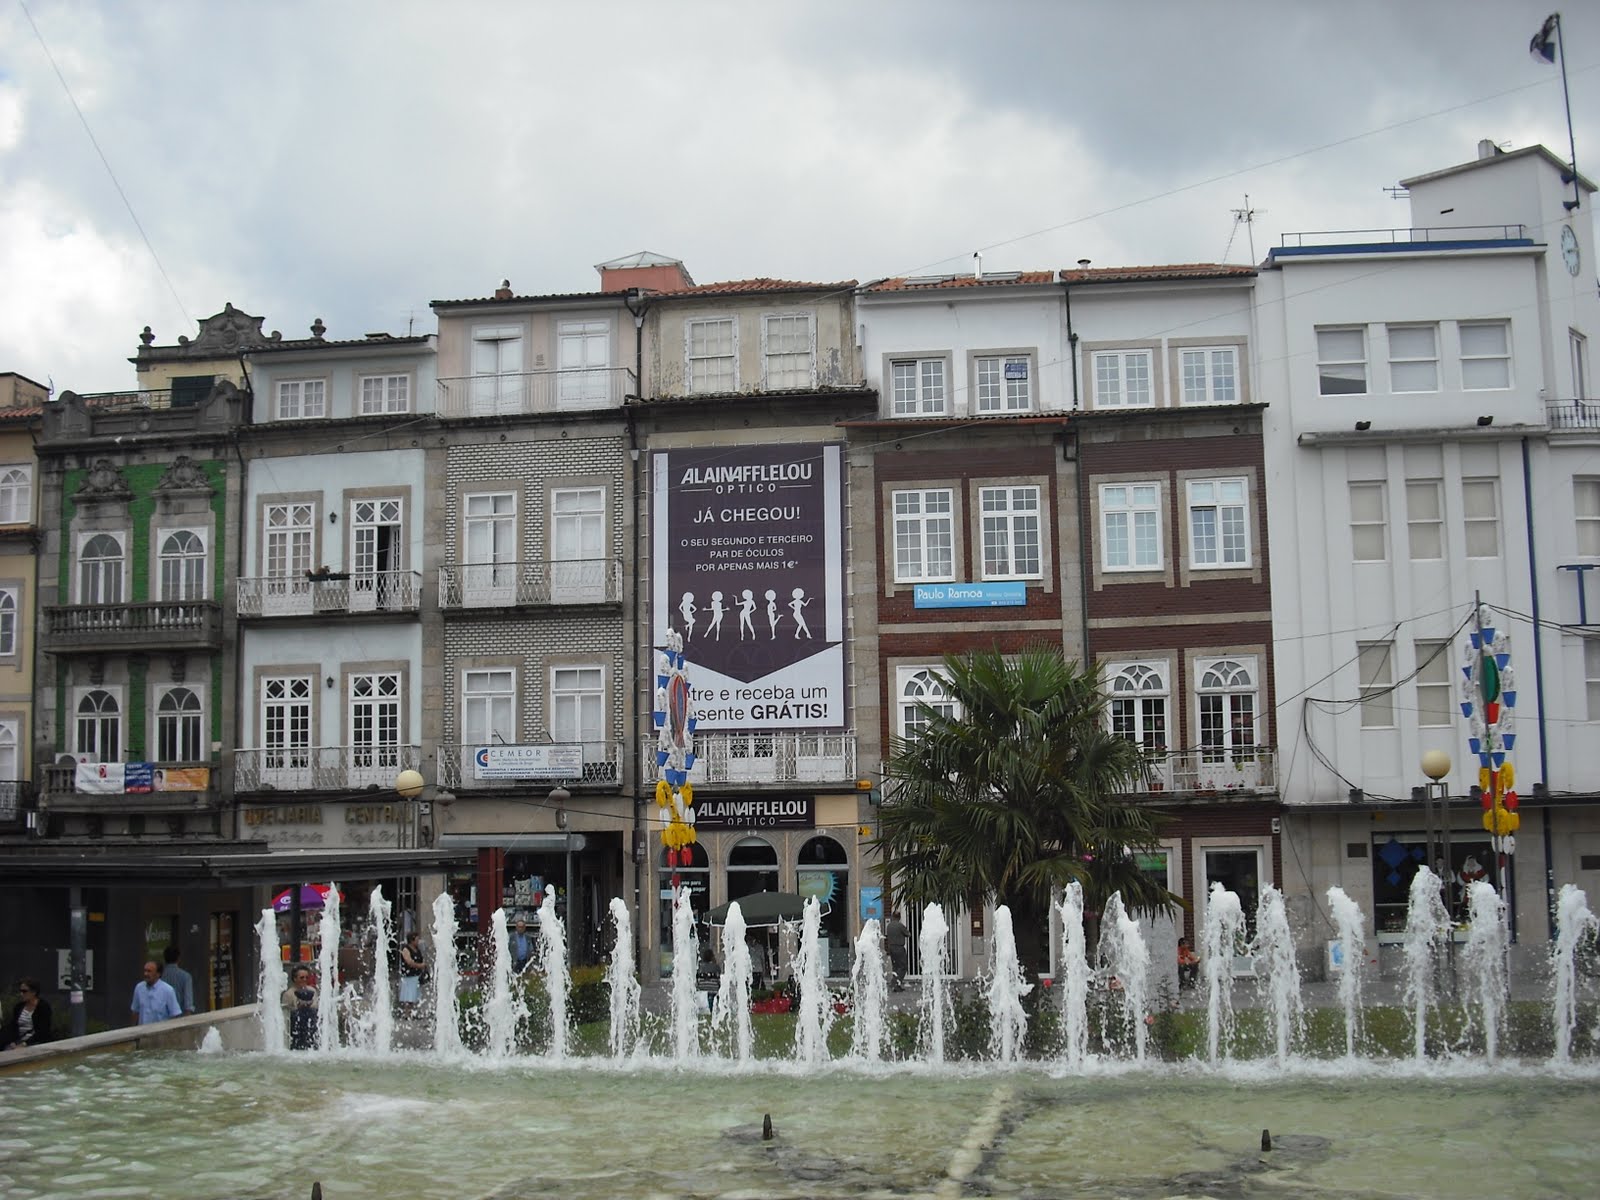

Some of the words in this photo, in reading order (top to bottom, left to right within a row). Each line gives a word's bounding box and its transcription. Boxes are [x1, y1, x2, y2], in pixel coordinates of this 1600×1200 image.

[715, 483, 776, 494] OPTICO
[693, 506, 715, 524] JÁ
[720, 506, 801, 522] CHEGOU!
[680, 539, 688, 547] O
[690, 538, 709, 547] SEU
[711, 537, 757, 546] SEGUNDO
[758, 536, 765, 544] E
[767, 534, 813, 545] TERCEIRO
[709, 550, 729, 559] PAR
[731, 550, 743, 558] DE
[745, 548, 784, 558] ÓCULOS
[695, 564, 715, 572] POR
[717, 563, 754, 571] APENAS
[756, 562, 779, 570] MAIS
[917, 587, 944, 600] Paulo
[948, 587, 983, 599] Ramoa
[687, 687, 714, 702] tre
[719, 689, 730, 701] e
[736, 684, 795, 700] receba
[801, 686, 827, 699] um
[750, 700, 828, 720] GRÁTIS!
[490, 749, 542, 758] CEMEOR
[727, 816, 776, 826] OPTICO
